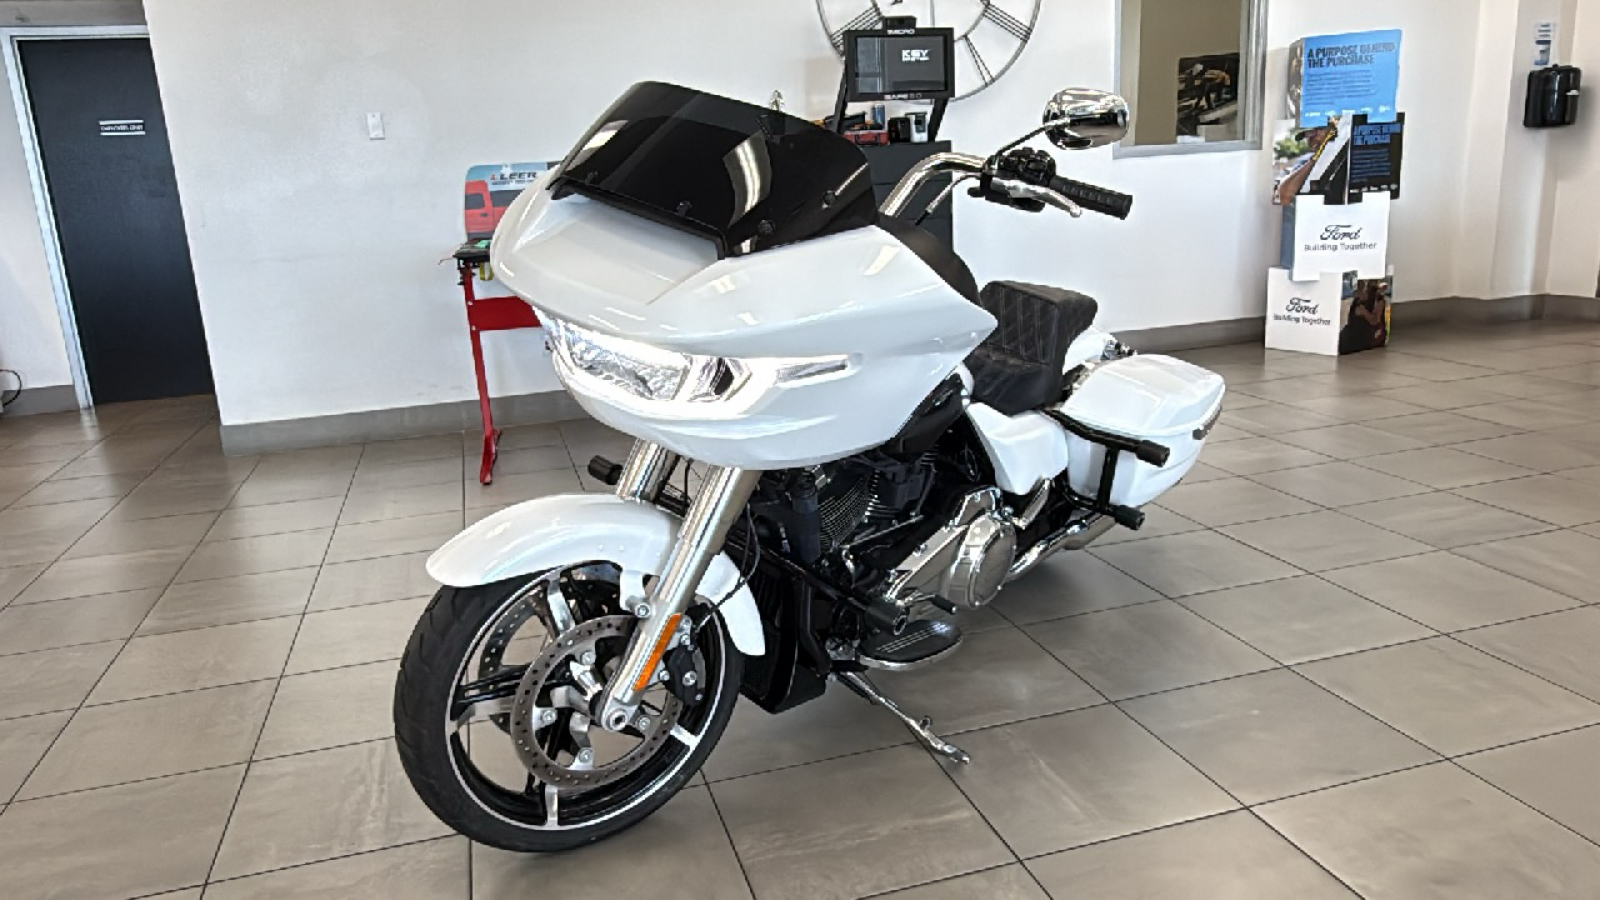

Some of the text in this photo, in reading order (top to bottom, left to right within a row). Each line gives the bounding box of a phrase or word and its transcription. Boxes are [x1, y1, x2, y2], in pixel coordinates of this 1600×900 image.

[1316, 45, 1358, 57] PURPOSE
[1308, 54, 1374, 68] THE PURCHASE
[500, 172, 537, 180] LEER
[1320, 225, 1362, 240] Ford
[1340, 242, 1377, 250] Together
[1286, 297, 1319, 315] Ford
[1274, 314, 1331, 325] Building Together
